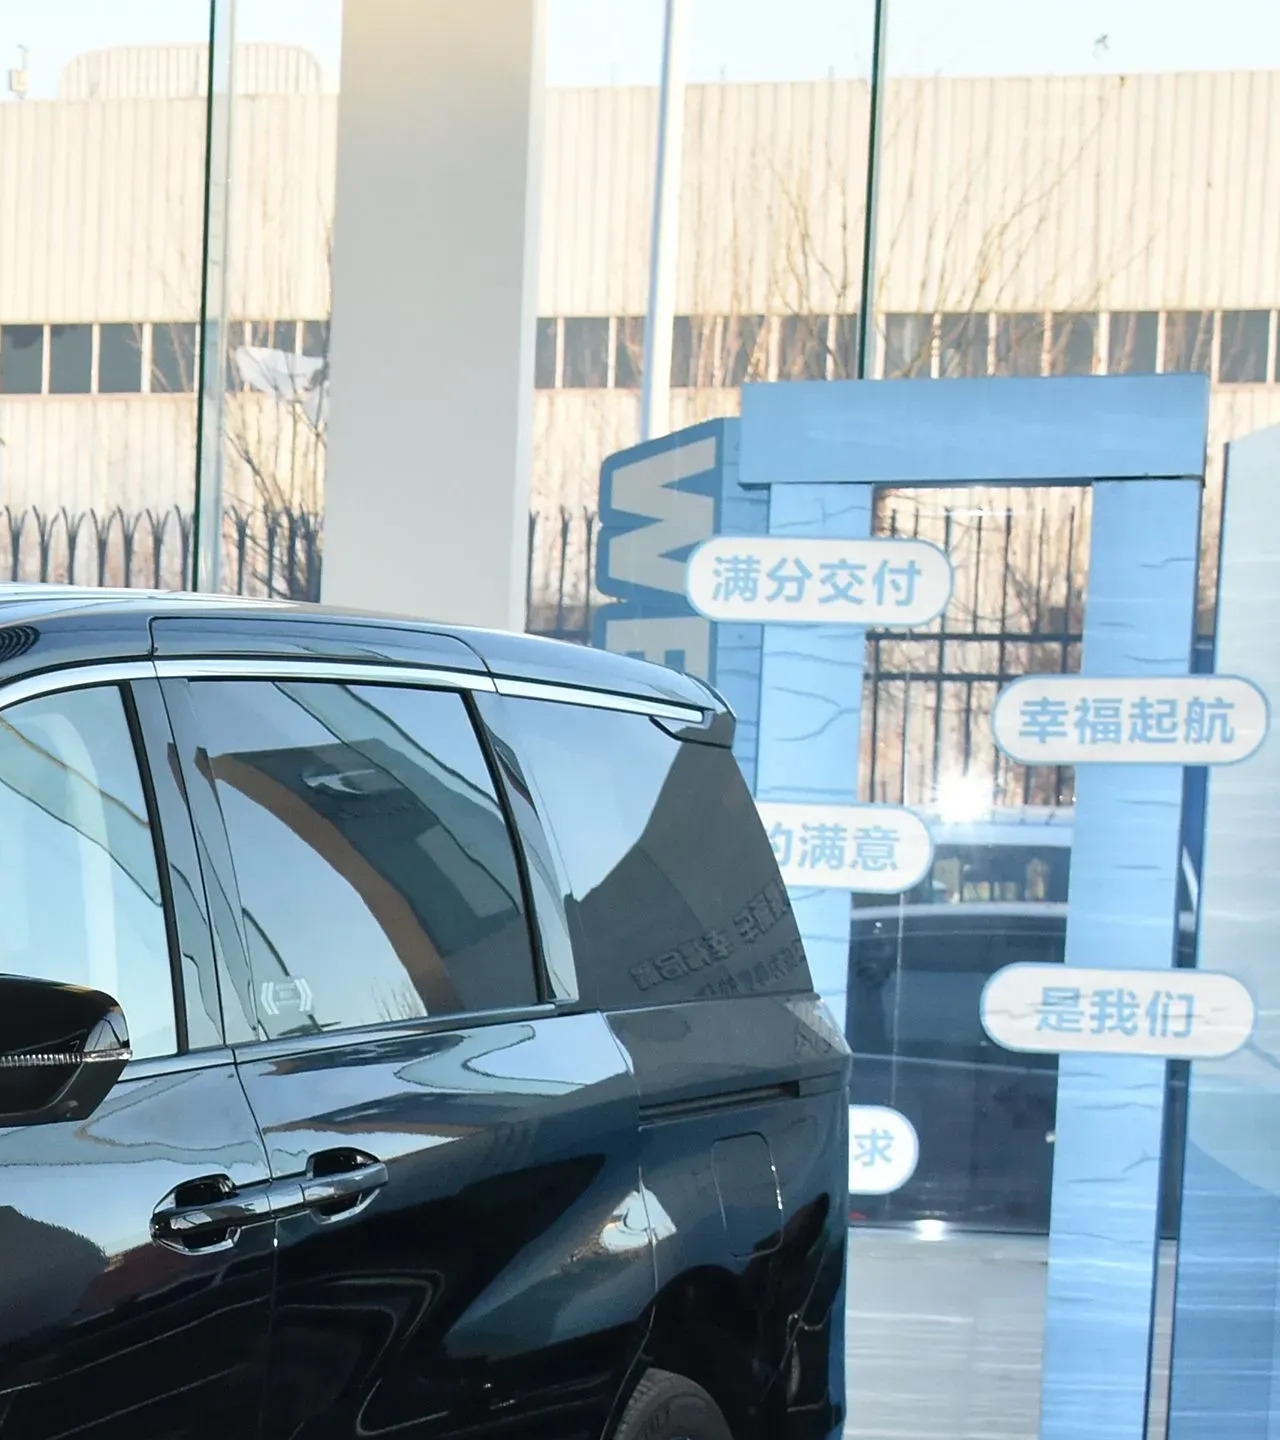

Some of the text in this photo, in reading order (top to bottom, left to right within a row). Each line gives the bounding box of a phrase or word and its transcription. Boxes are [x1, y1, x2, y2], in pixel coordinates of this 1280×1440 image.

[711, 554, 923, 606] 满分交付
[1019, 696, 1236, 746] 幸福起航
[1035, 985, 1195, 1040] 是我们
[853, 1128, 895, 1168] 求
